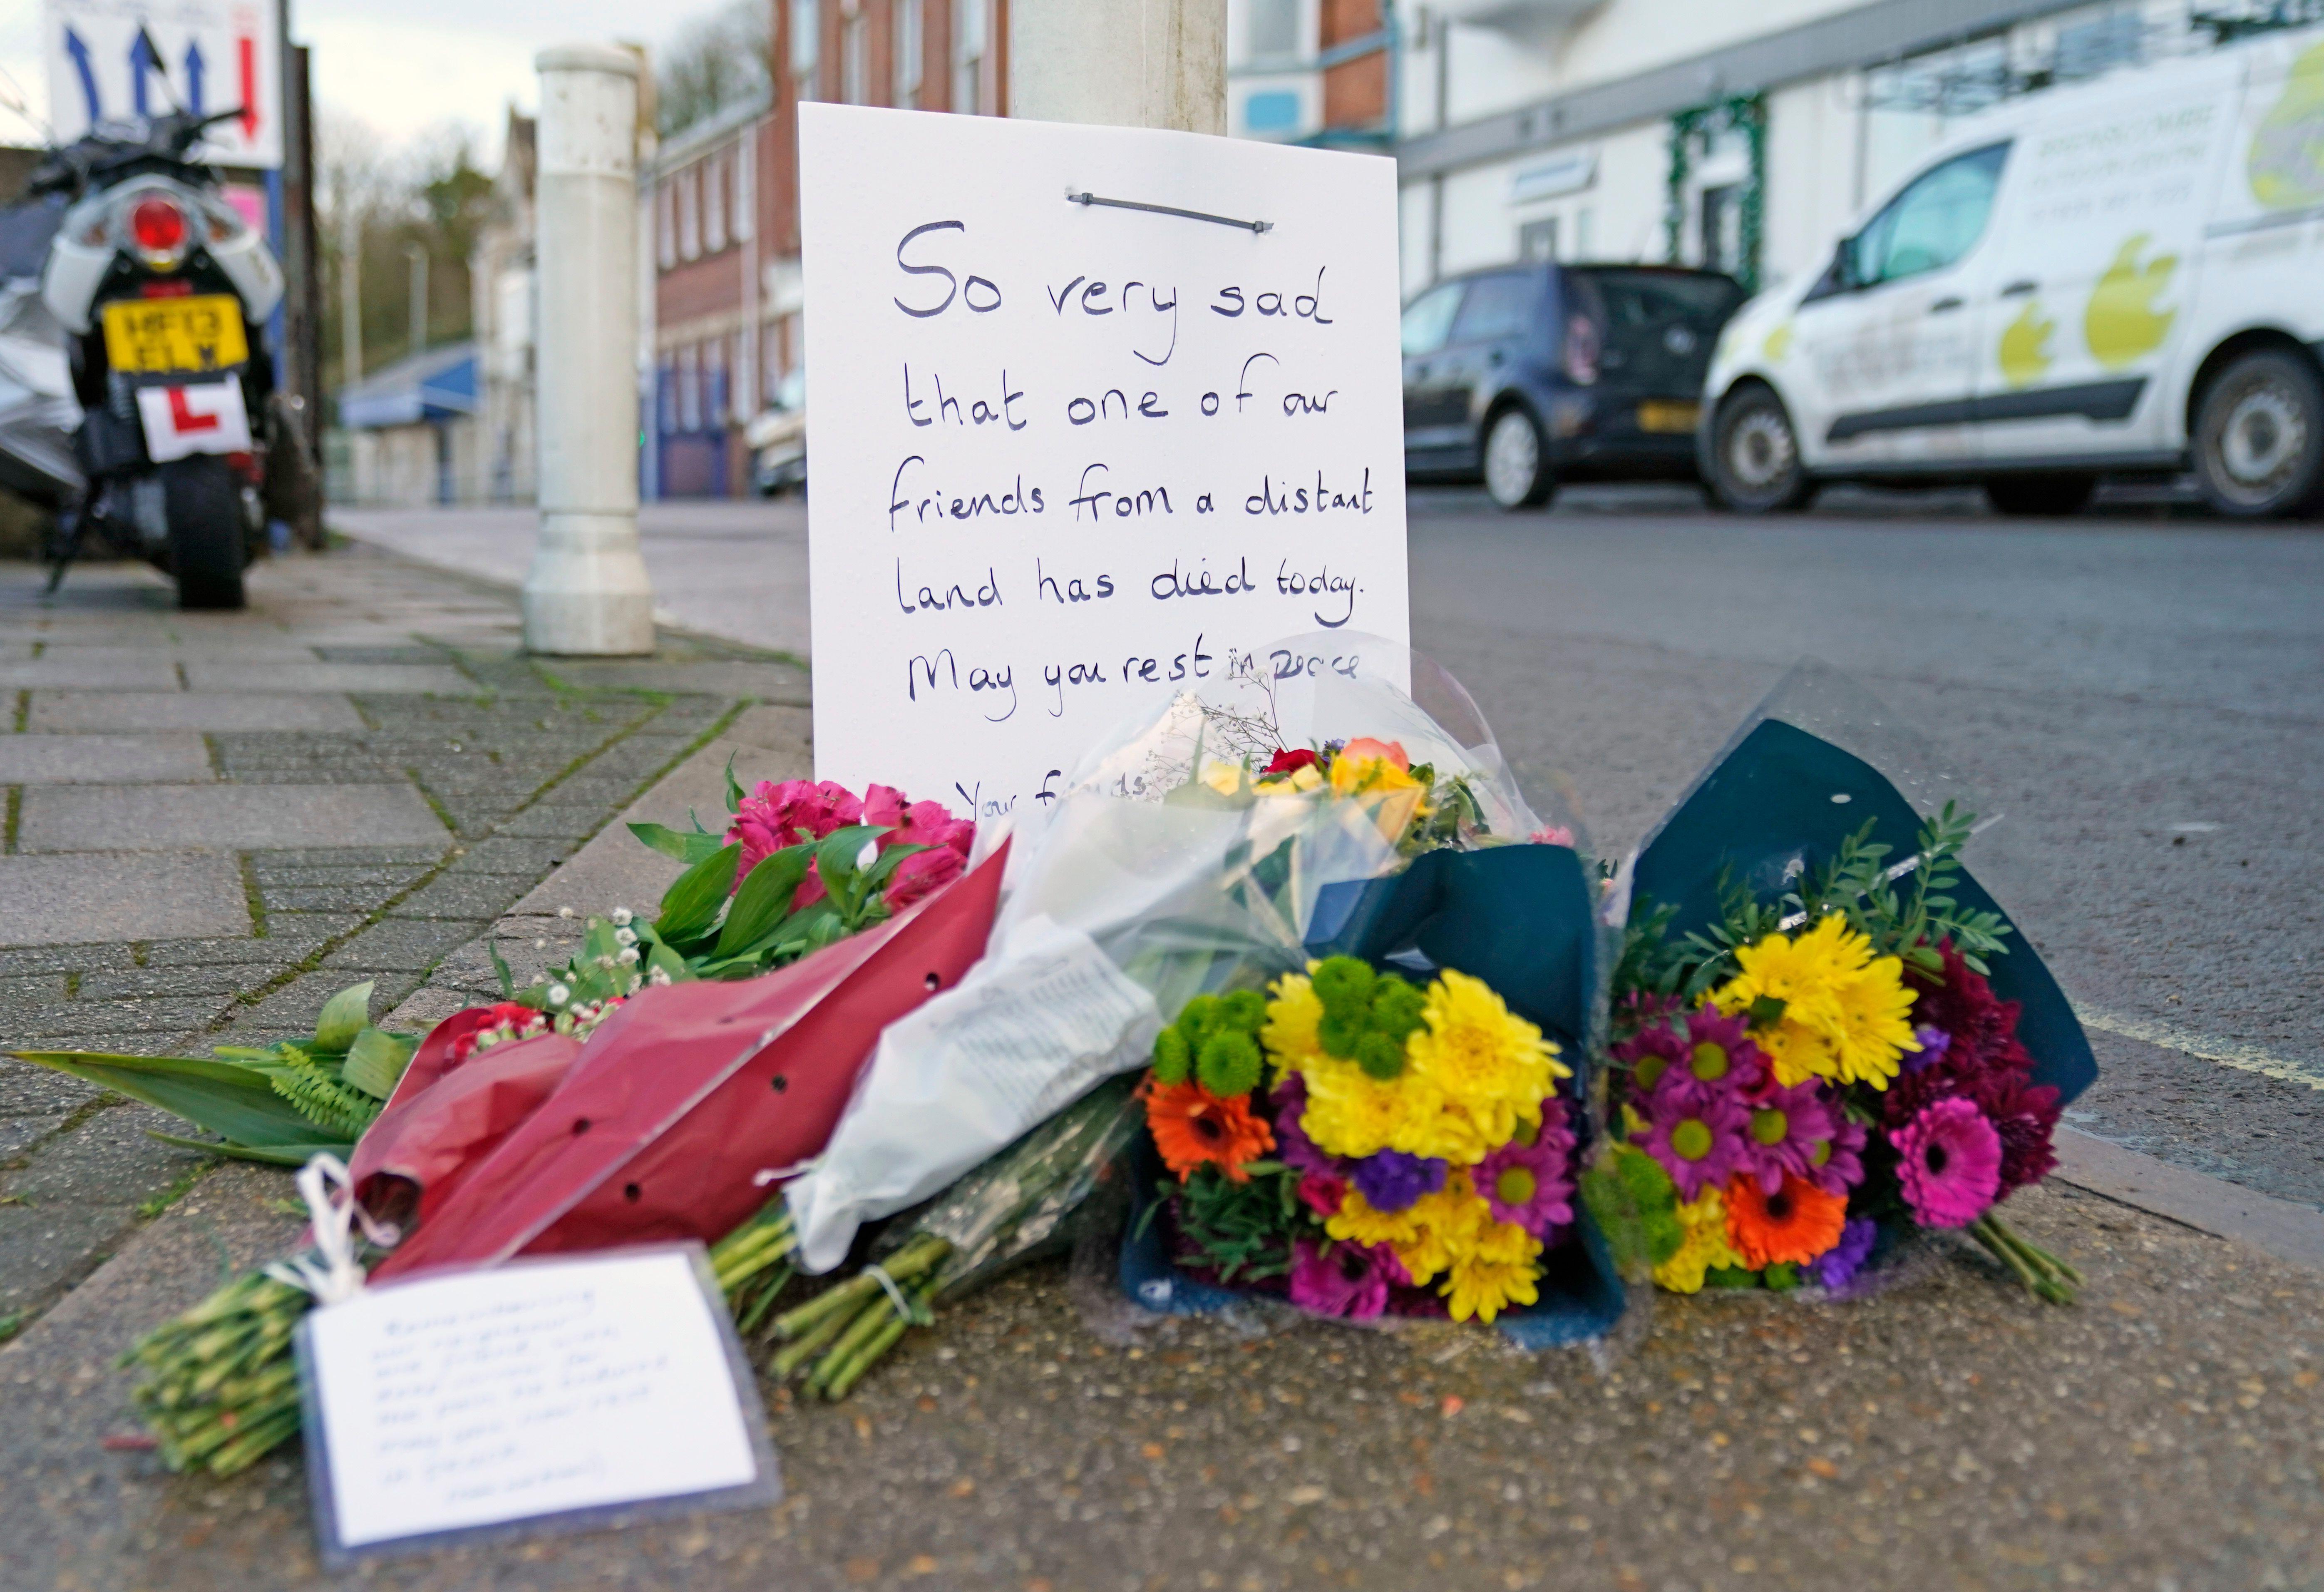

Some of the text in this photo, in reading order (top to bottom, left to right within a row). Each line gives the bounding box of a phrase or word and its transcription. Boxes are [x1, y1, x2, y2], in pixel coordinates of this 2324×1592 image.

[894, 221, 1333, 366] So very sad
[167, 387, 219, 435] L
[905, 353, 1338, 431] that one of our
[889, 456, 1373, 532] friends from a distant
[897, 556, 1363, 628] land has died today.
[909, 649, 1016, 722] May
[1045, 662, 1106, 717] you
[1123, 633, 1212, 683] rest
[956, 781, 1016, 821] Your
